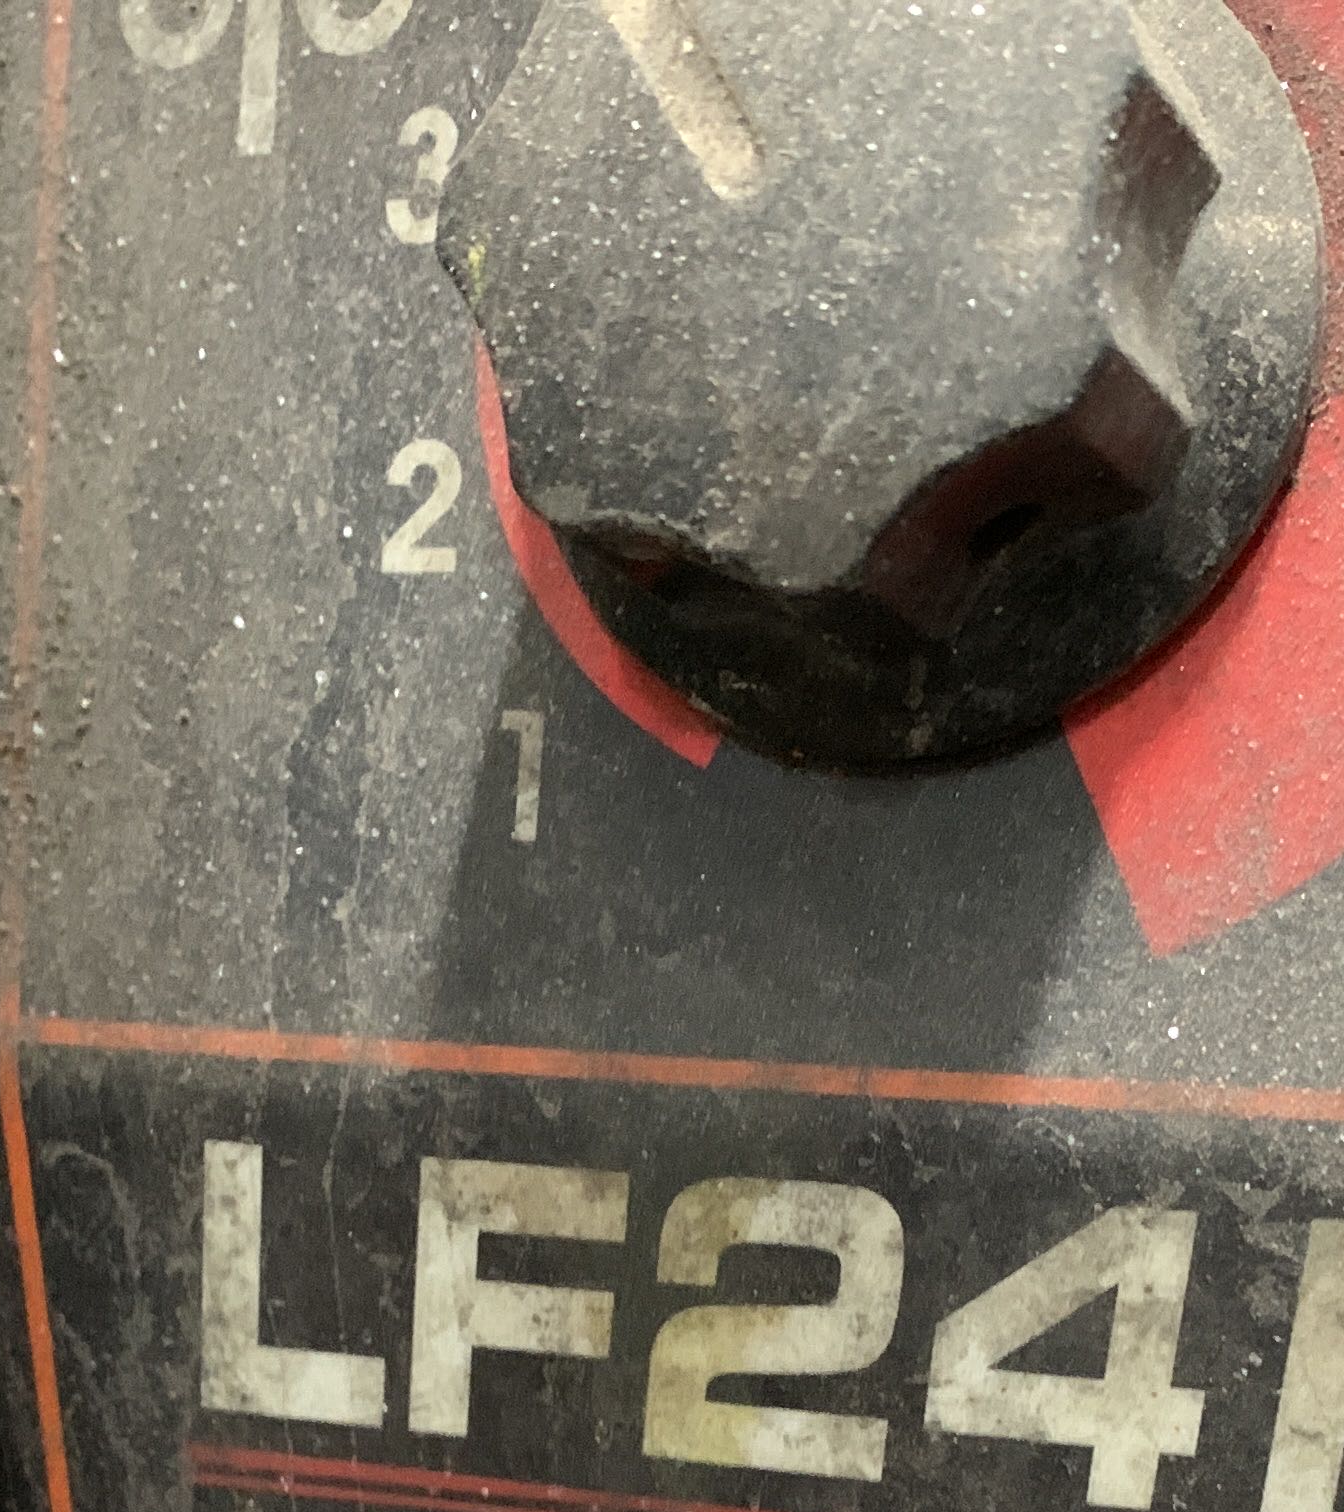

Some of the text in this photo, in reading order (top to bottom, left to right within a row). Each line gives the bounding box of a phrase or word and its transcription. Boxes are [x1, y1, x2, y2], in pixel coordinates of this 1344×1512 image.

[386, 106, 459, 244] 3
[381, 439, 462, 574] 2
[501, 710, 543, 842] 1
